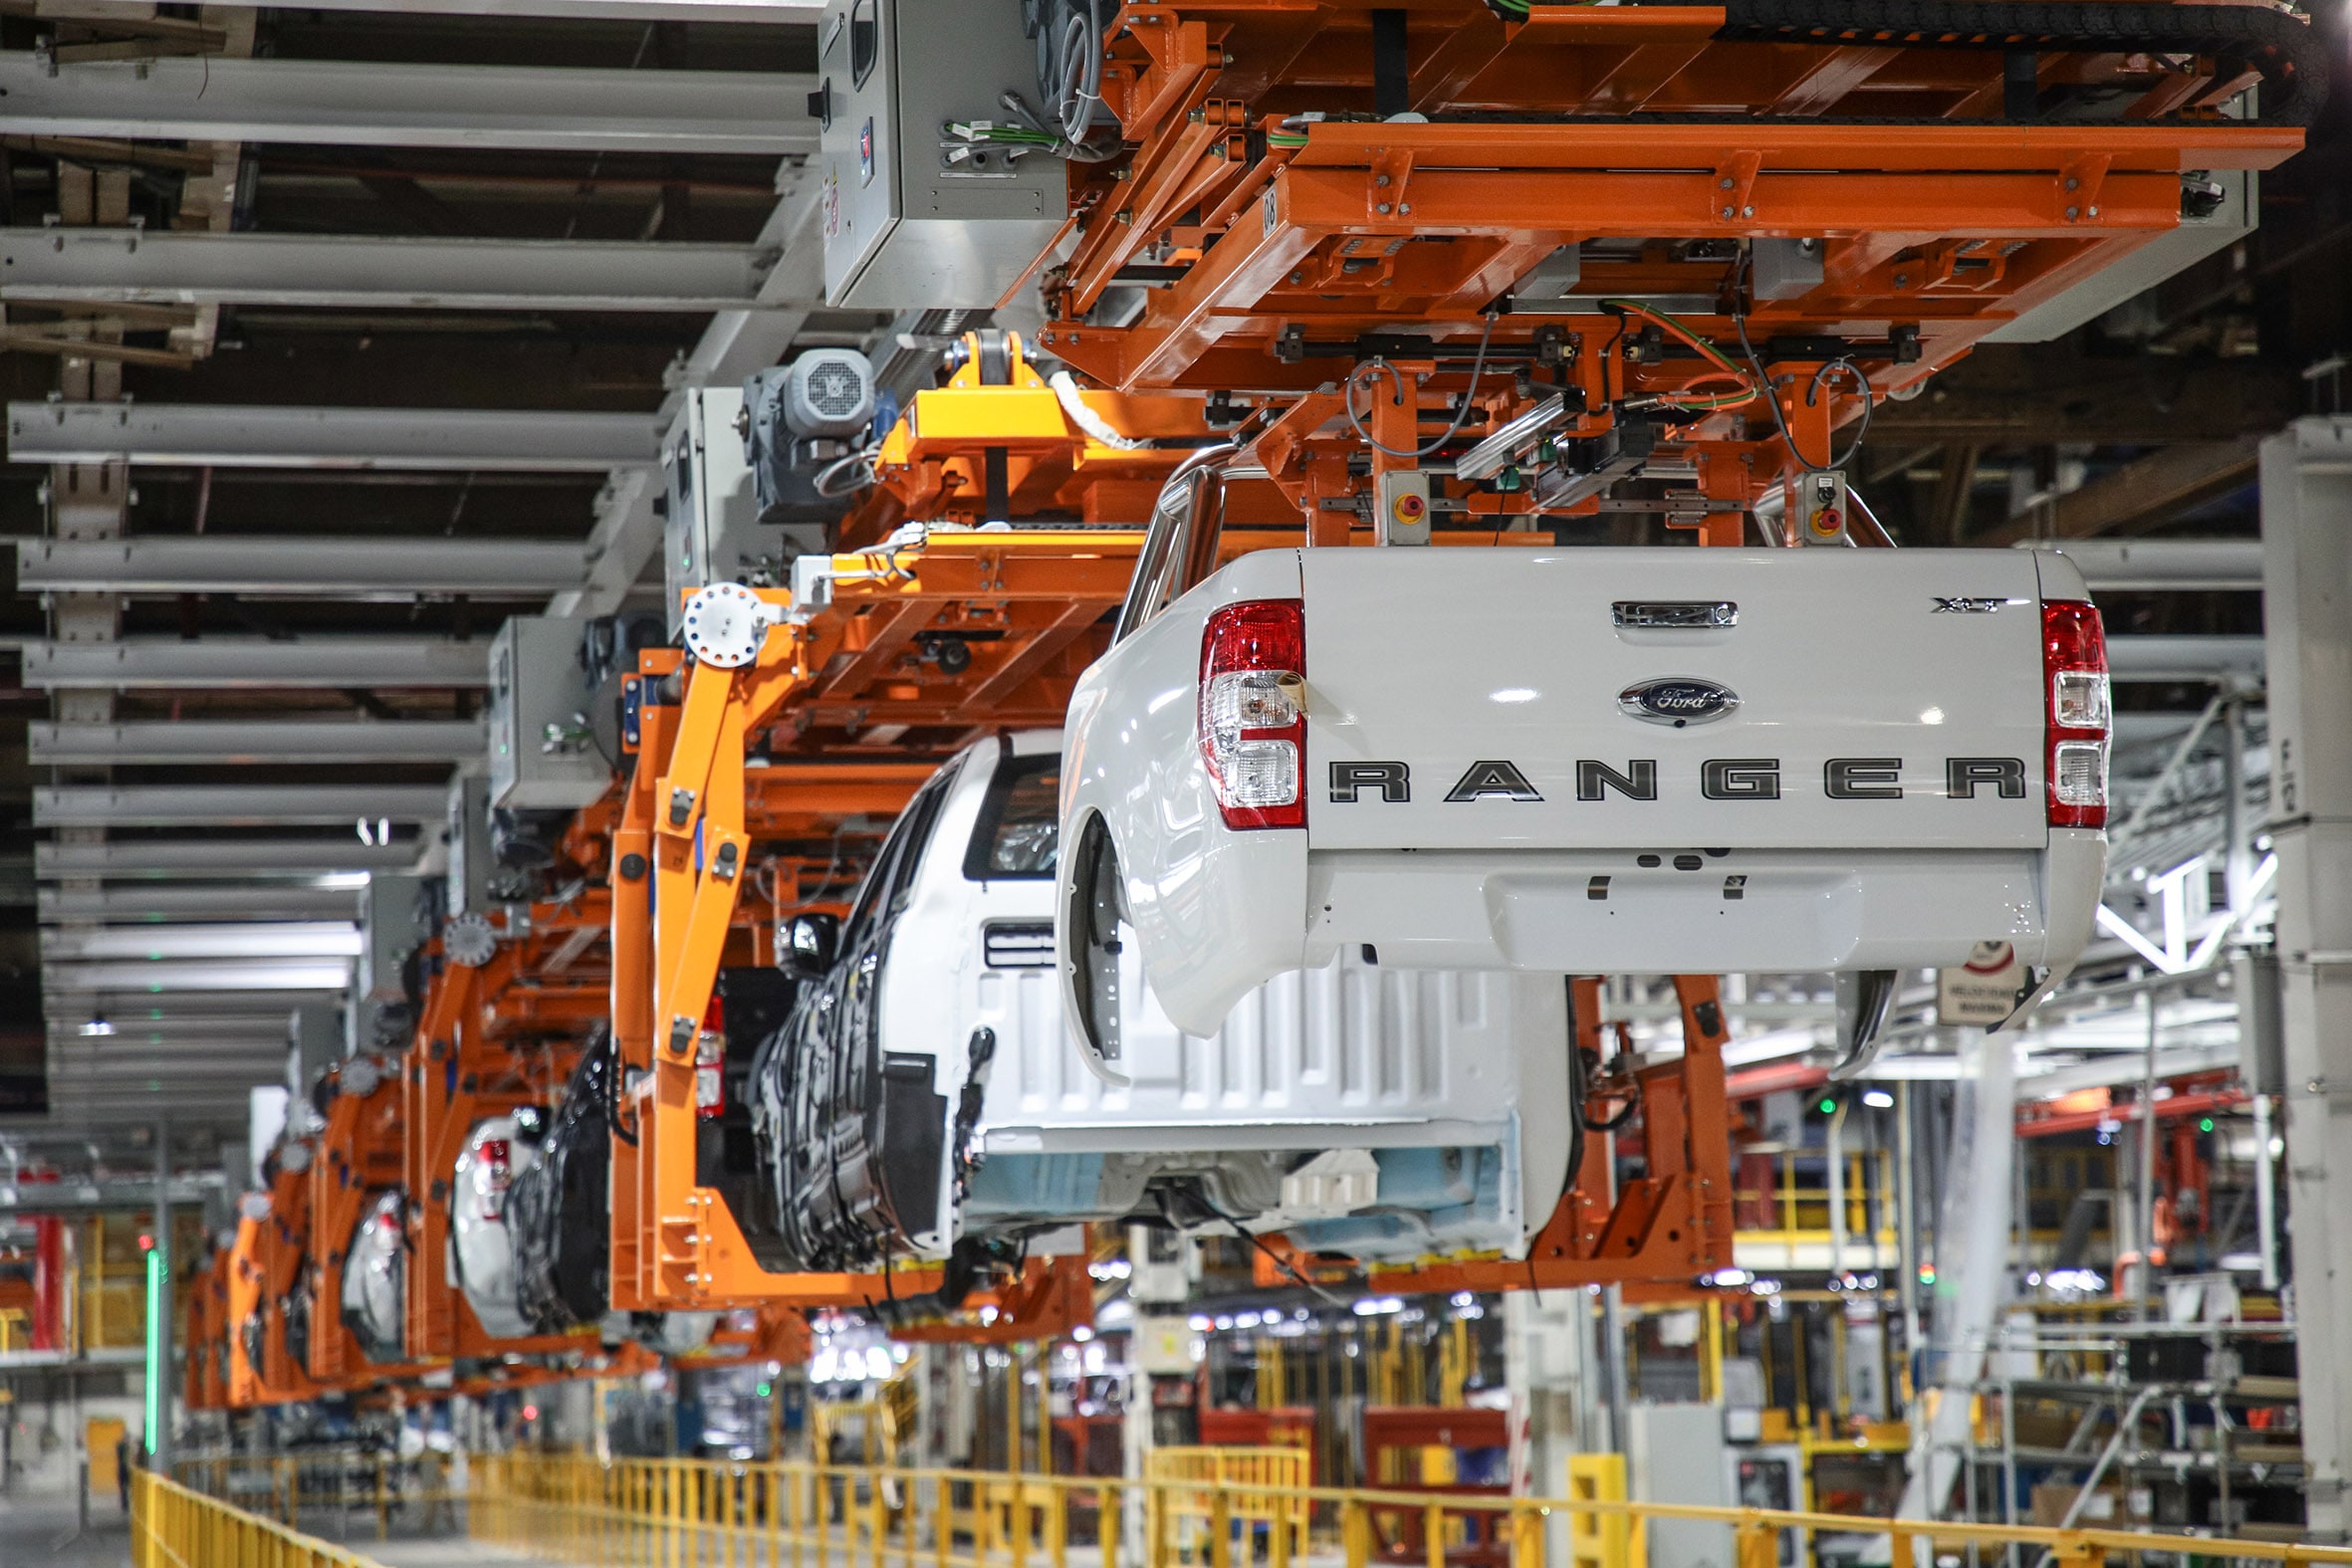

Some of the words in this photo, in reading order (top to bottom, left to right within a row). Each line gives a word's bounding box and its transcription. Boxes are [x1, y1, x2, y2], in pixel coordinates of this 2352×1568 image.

[1265, 192, 1275, 230] 08
[1656, 688, 1712, 708] Ford
[1329, 758, 2026, 802] RANGER
